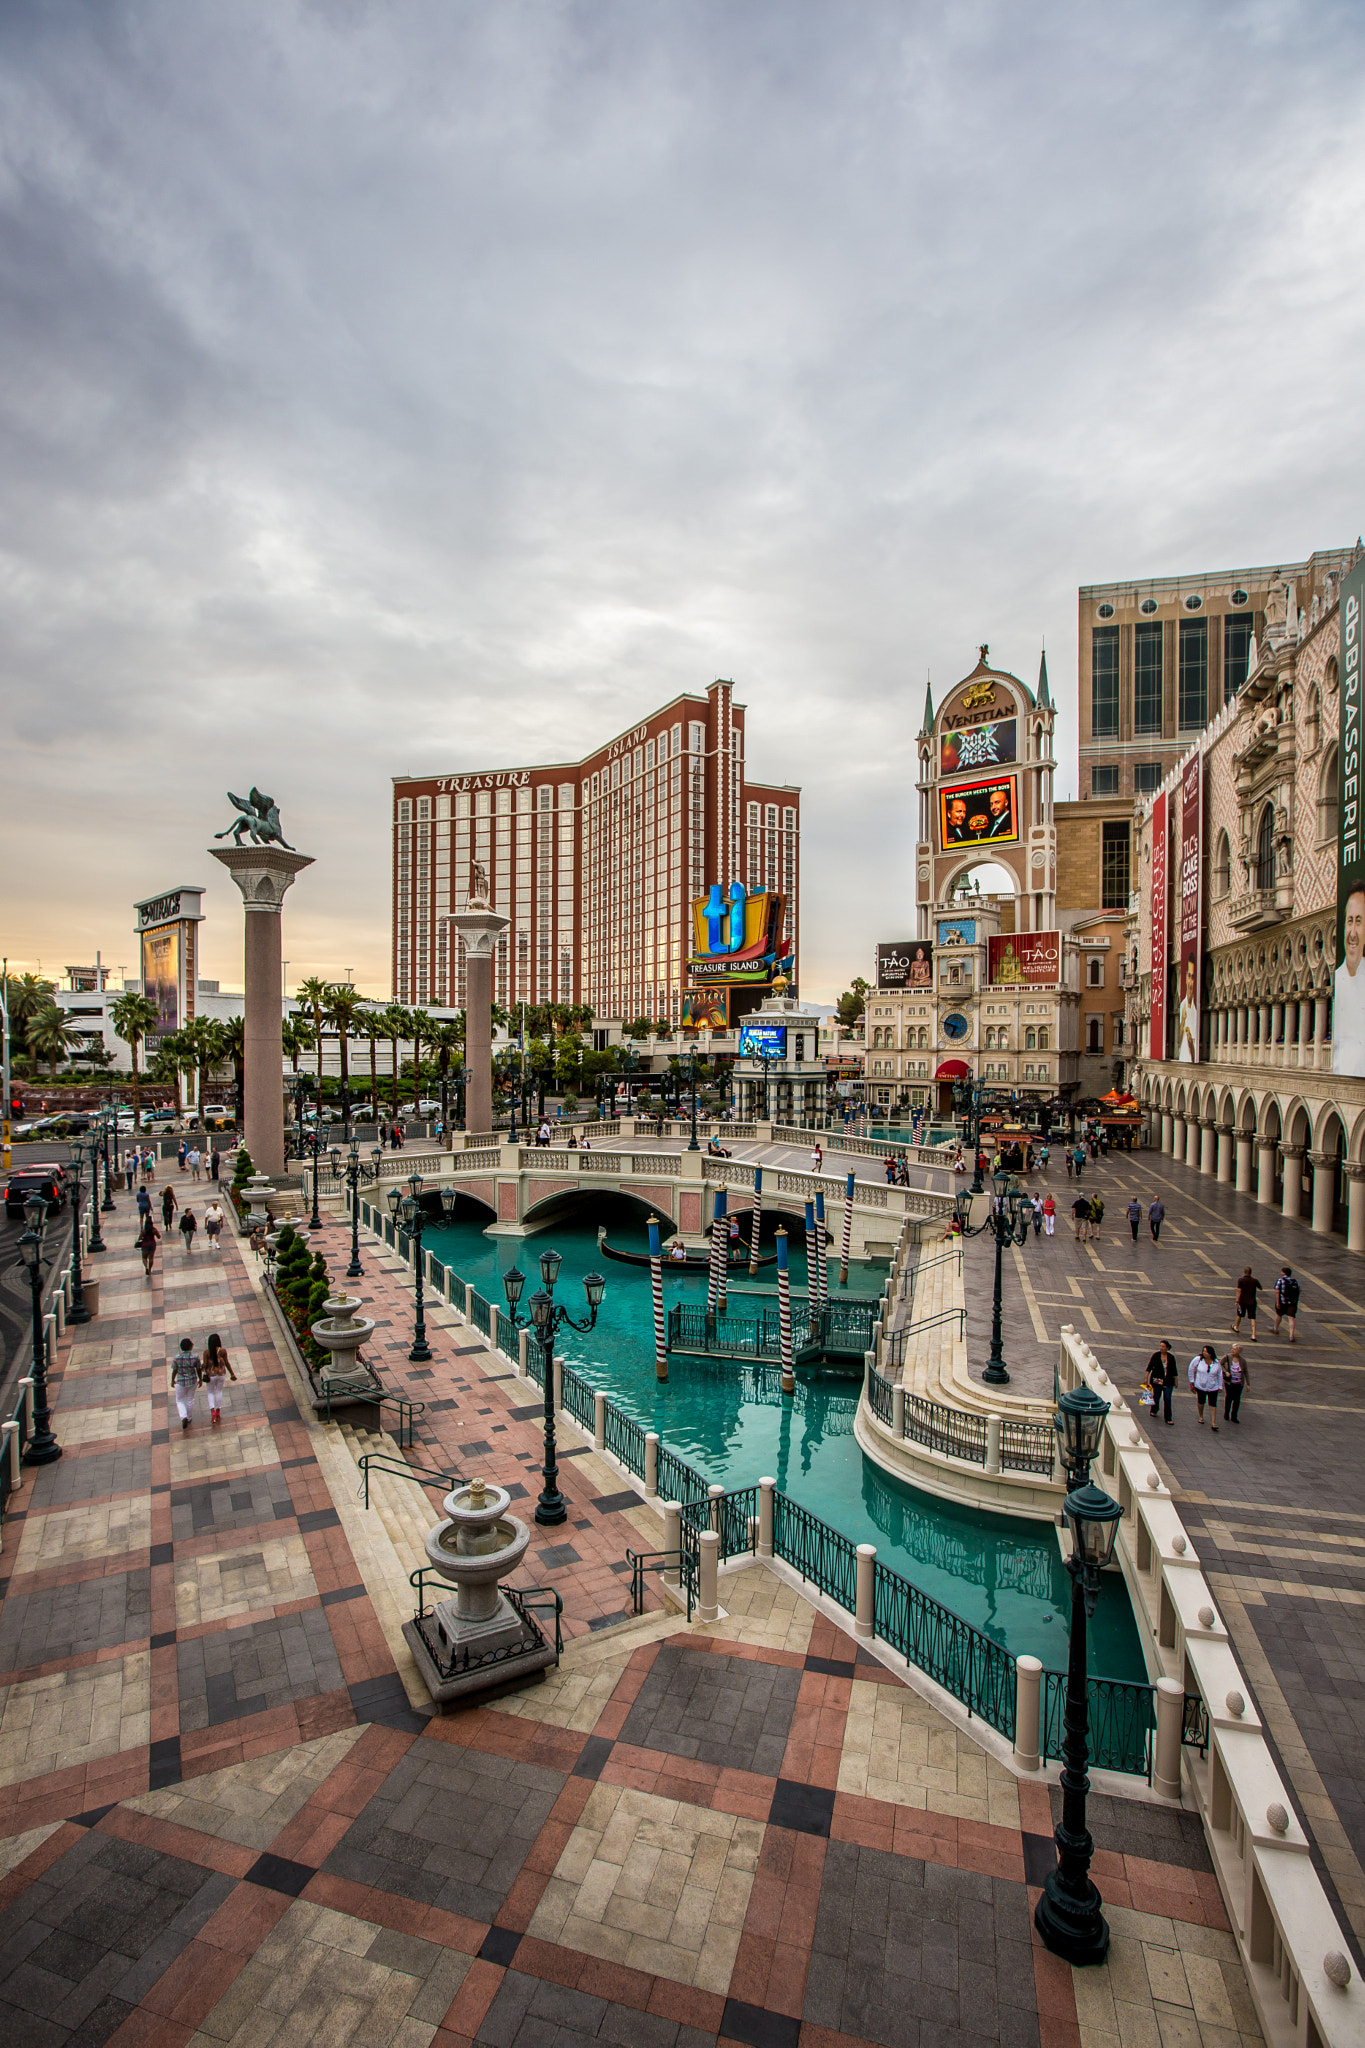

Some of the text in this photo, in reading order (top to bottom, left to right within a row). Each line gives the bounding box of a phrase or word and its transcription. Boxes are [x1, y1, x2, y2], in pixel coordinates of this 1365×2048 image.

[943, 704, 1015, 730] VENETIAN
[607, 725, 648, 762] ISLAND
[957, 724, 999, 756] ROCK
[956, 744, 1000, 771] AGES
[1343, 643, 1359, 866] BRASSERIE
[437, 771, 531, 792] TREASURE
[1183, 833, 1198, 860] TLC's
[1183, 853, 1198, 878] CAKE
[1182, 873, 1198, 898] BOSS
[141, 895, 181, 925] MIRAGE
[1182, 892, 1197, 916] NOW
[691, 961, 759, 973] TREASURE ISLAND
[879, 957, 910, 969] TAO
[1021, 948, 1058, 962] TAO
